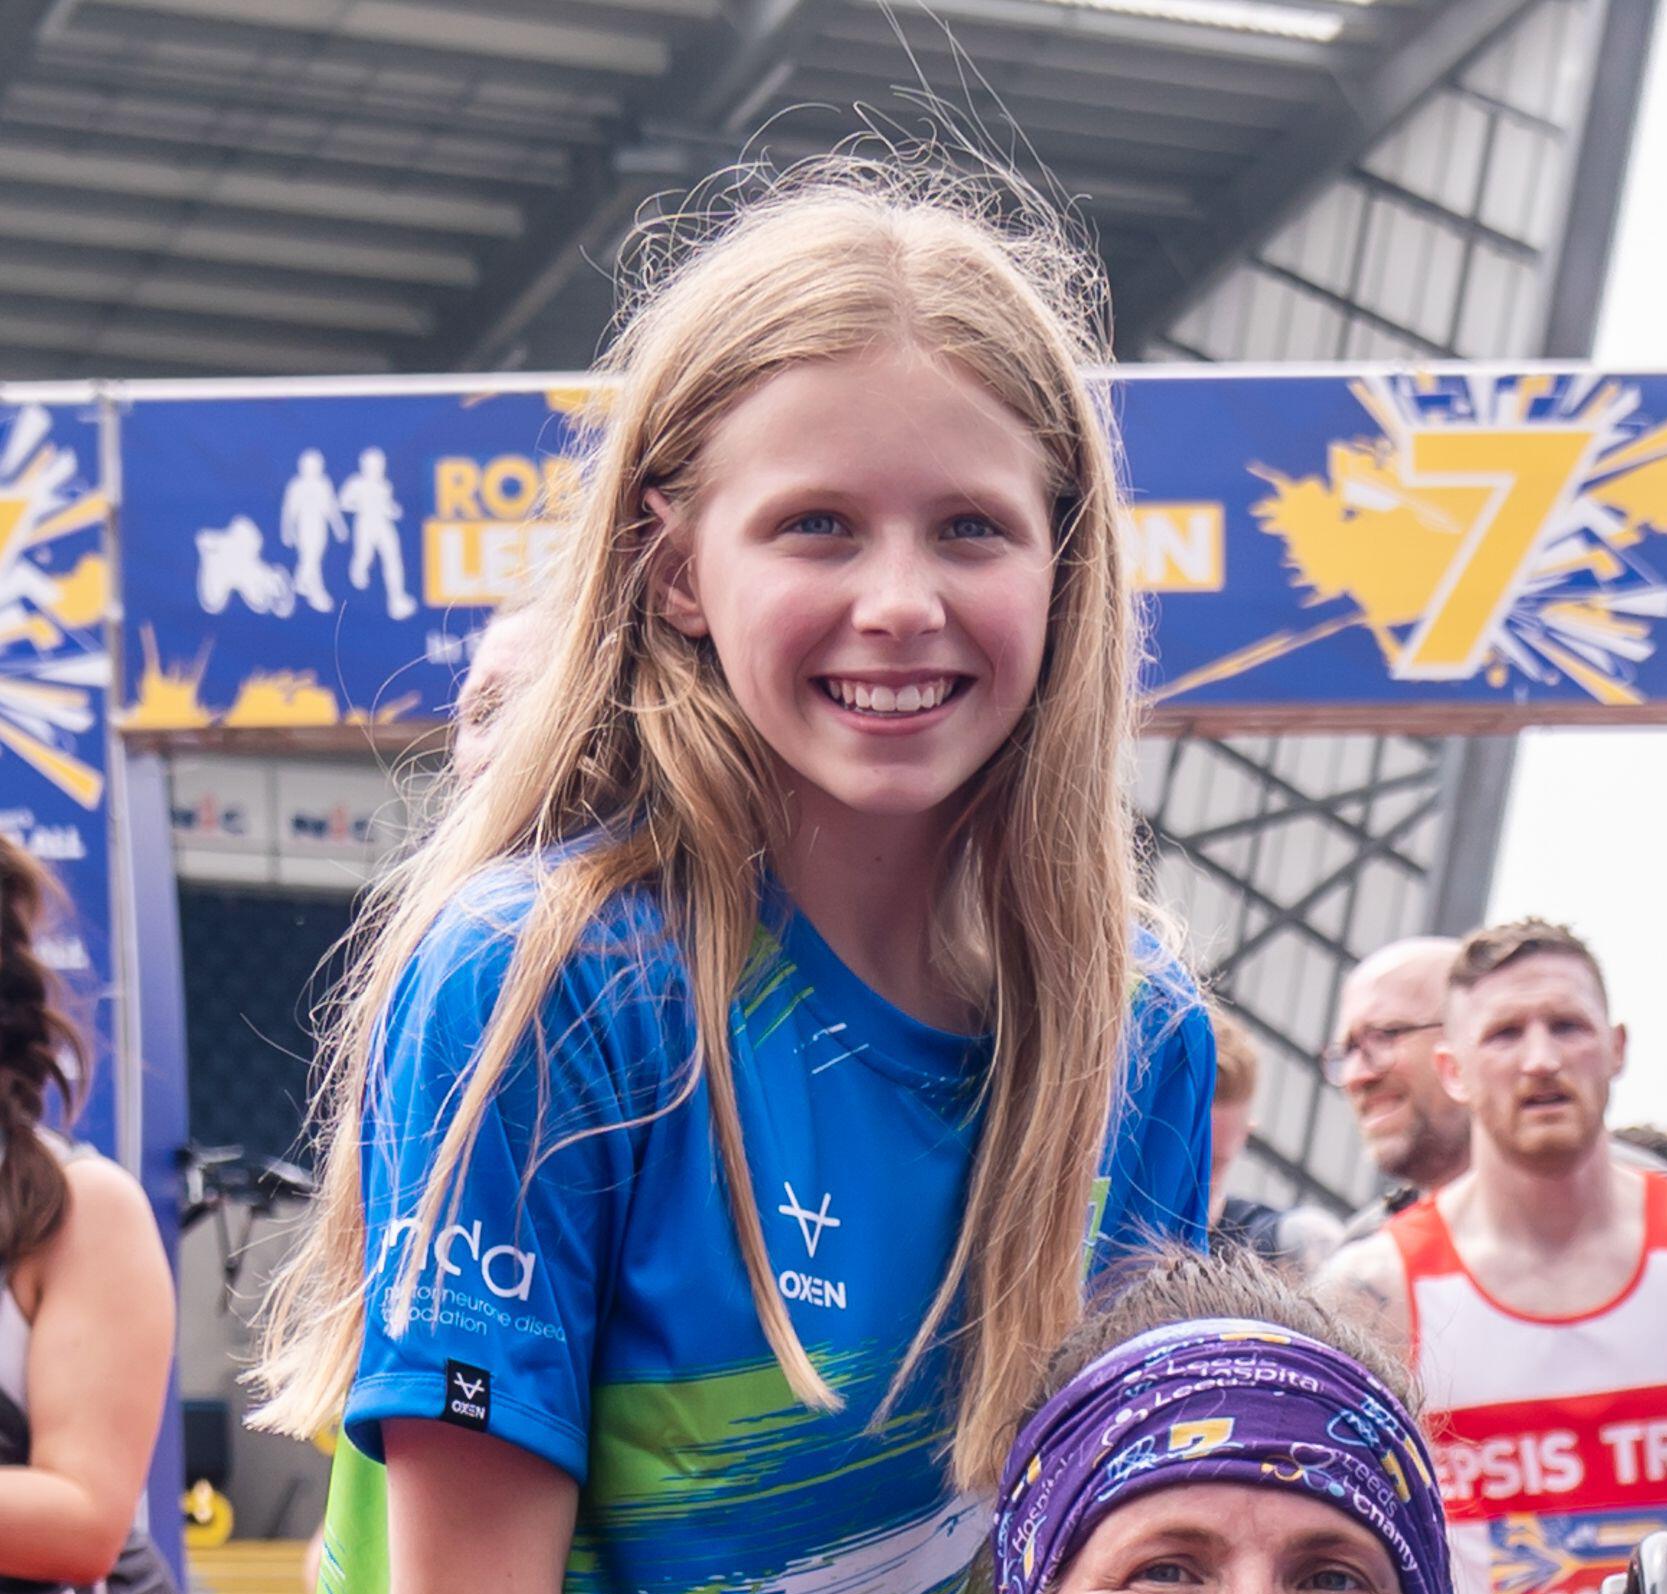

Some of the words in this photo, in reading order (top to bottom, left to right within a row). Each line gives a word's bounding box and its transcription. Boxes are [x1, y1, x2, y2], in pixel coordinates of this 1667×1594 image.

[779, 1270, 847, 1310] OXEN
[451, 1400, 487, 1420] OXEN
[1436, 1428, 1585, 1501] EPSIS
